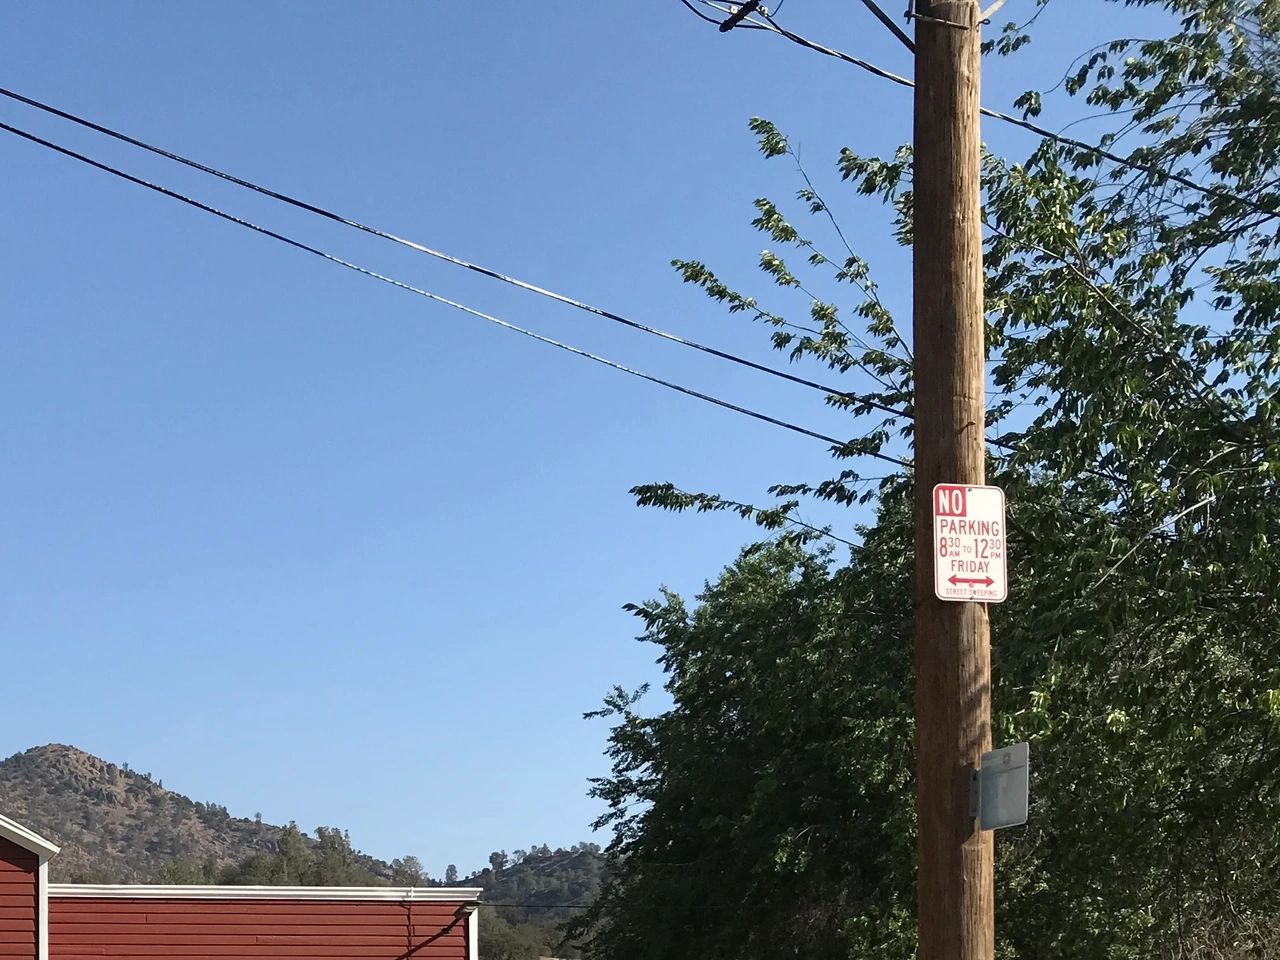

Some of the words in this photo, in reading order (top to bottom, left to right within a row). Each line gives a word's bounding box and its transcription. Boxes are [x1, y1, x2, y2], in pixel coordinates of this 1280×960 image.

[939, 489, 963, 514] NO
[940, 519, 1000, 537] PARKING
[962, 545, 972, 554] TO
[951, 560, 990, 573] FRIDAY
[946, 587, 967, 596] STREET
